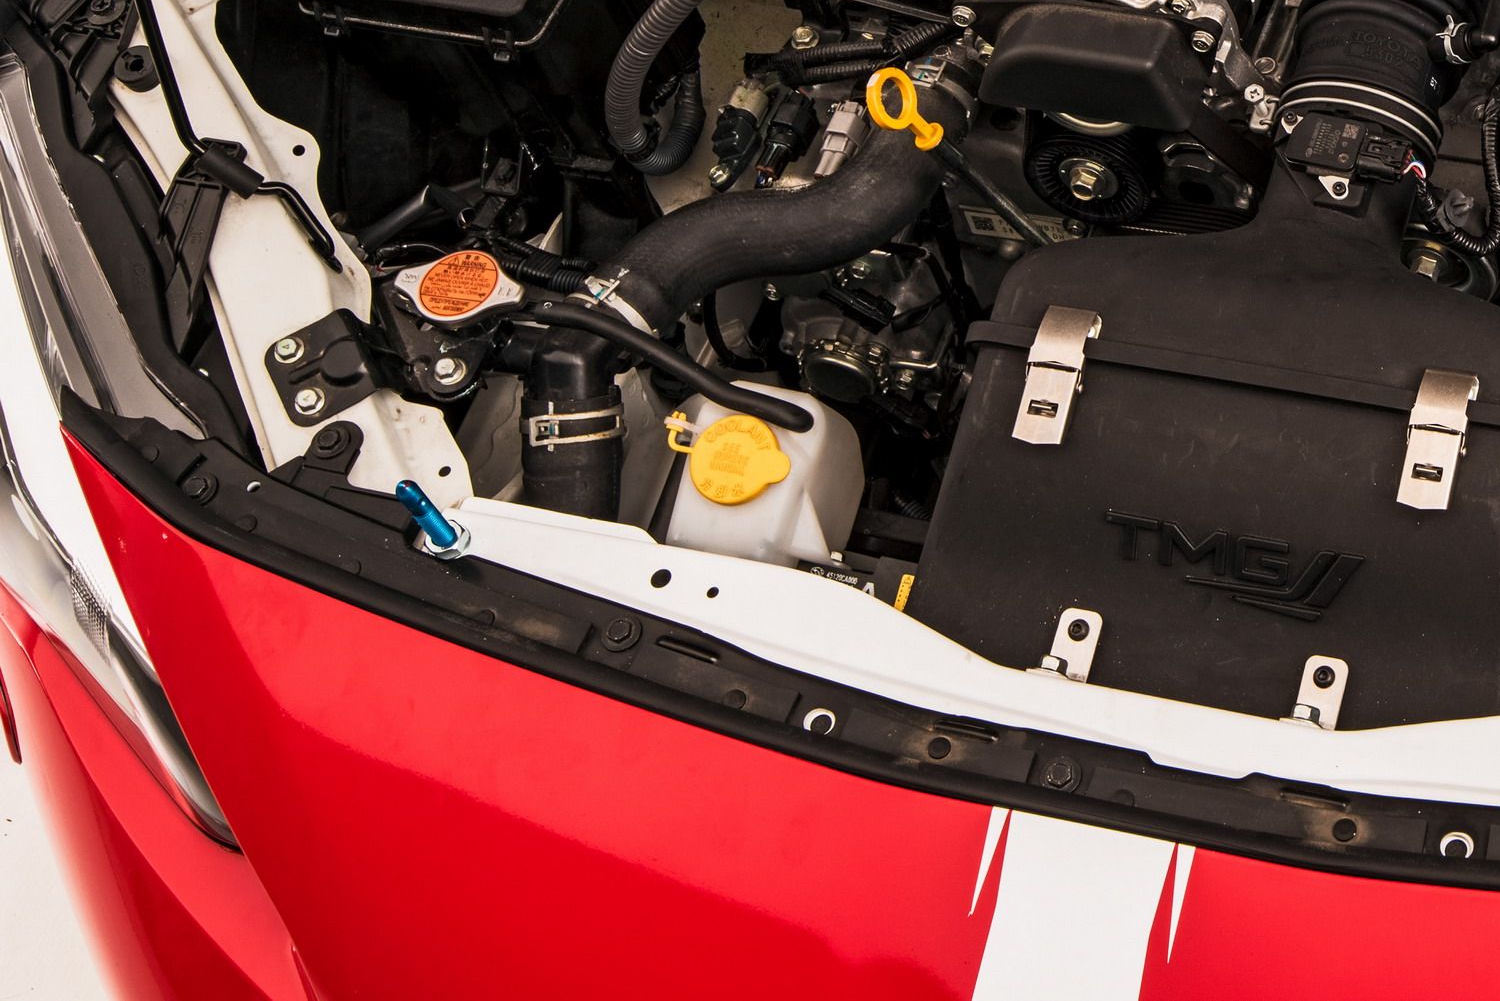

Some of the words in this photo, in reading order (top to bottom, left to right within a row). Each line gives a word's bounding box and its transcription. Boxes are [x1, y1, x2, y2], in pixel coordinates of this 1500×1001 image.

[1351, 29, 1423, 71] TOYOTA
[704, 419, 771, 451] COOLANT
[1105, 510, 1290, 586] TMG
